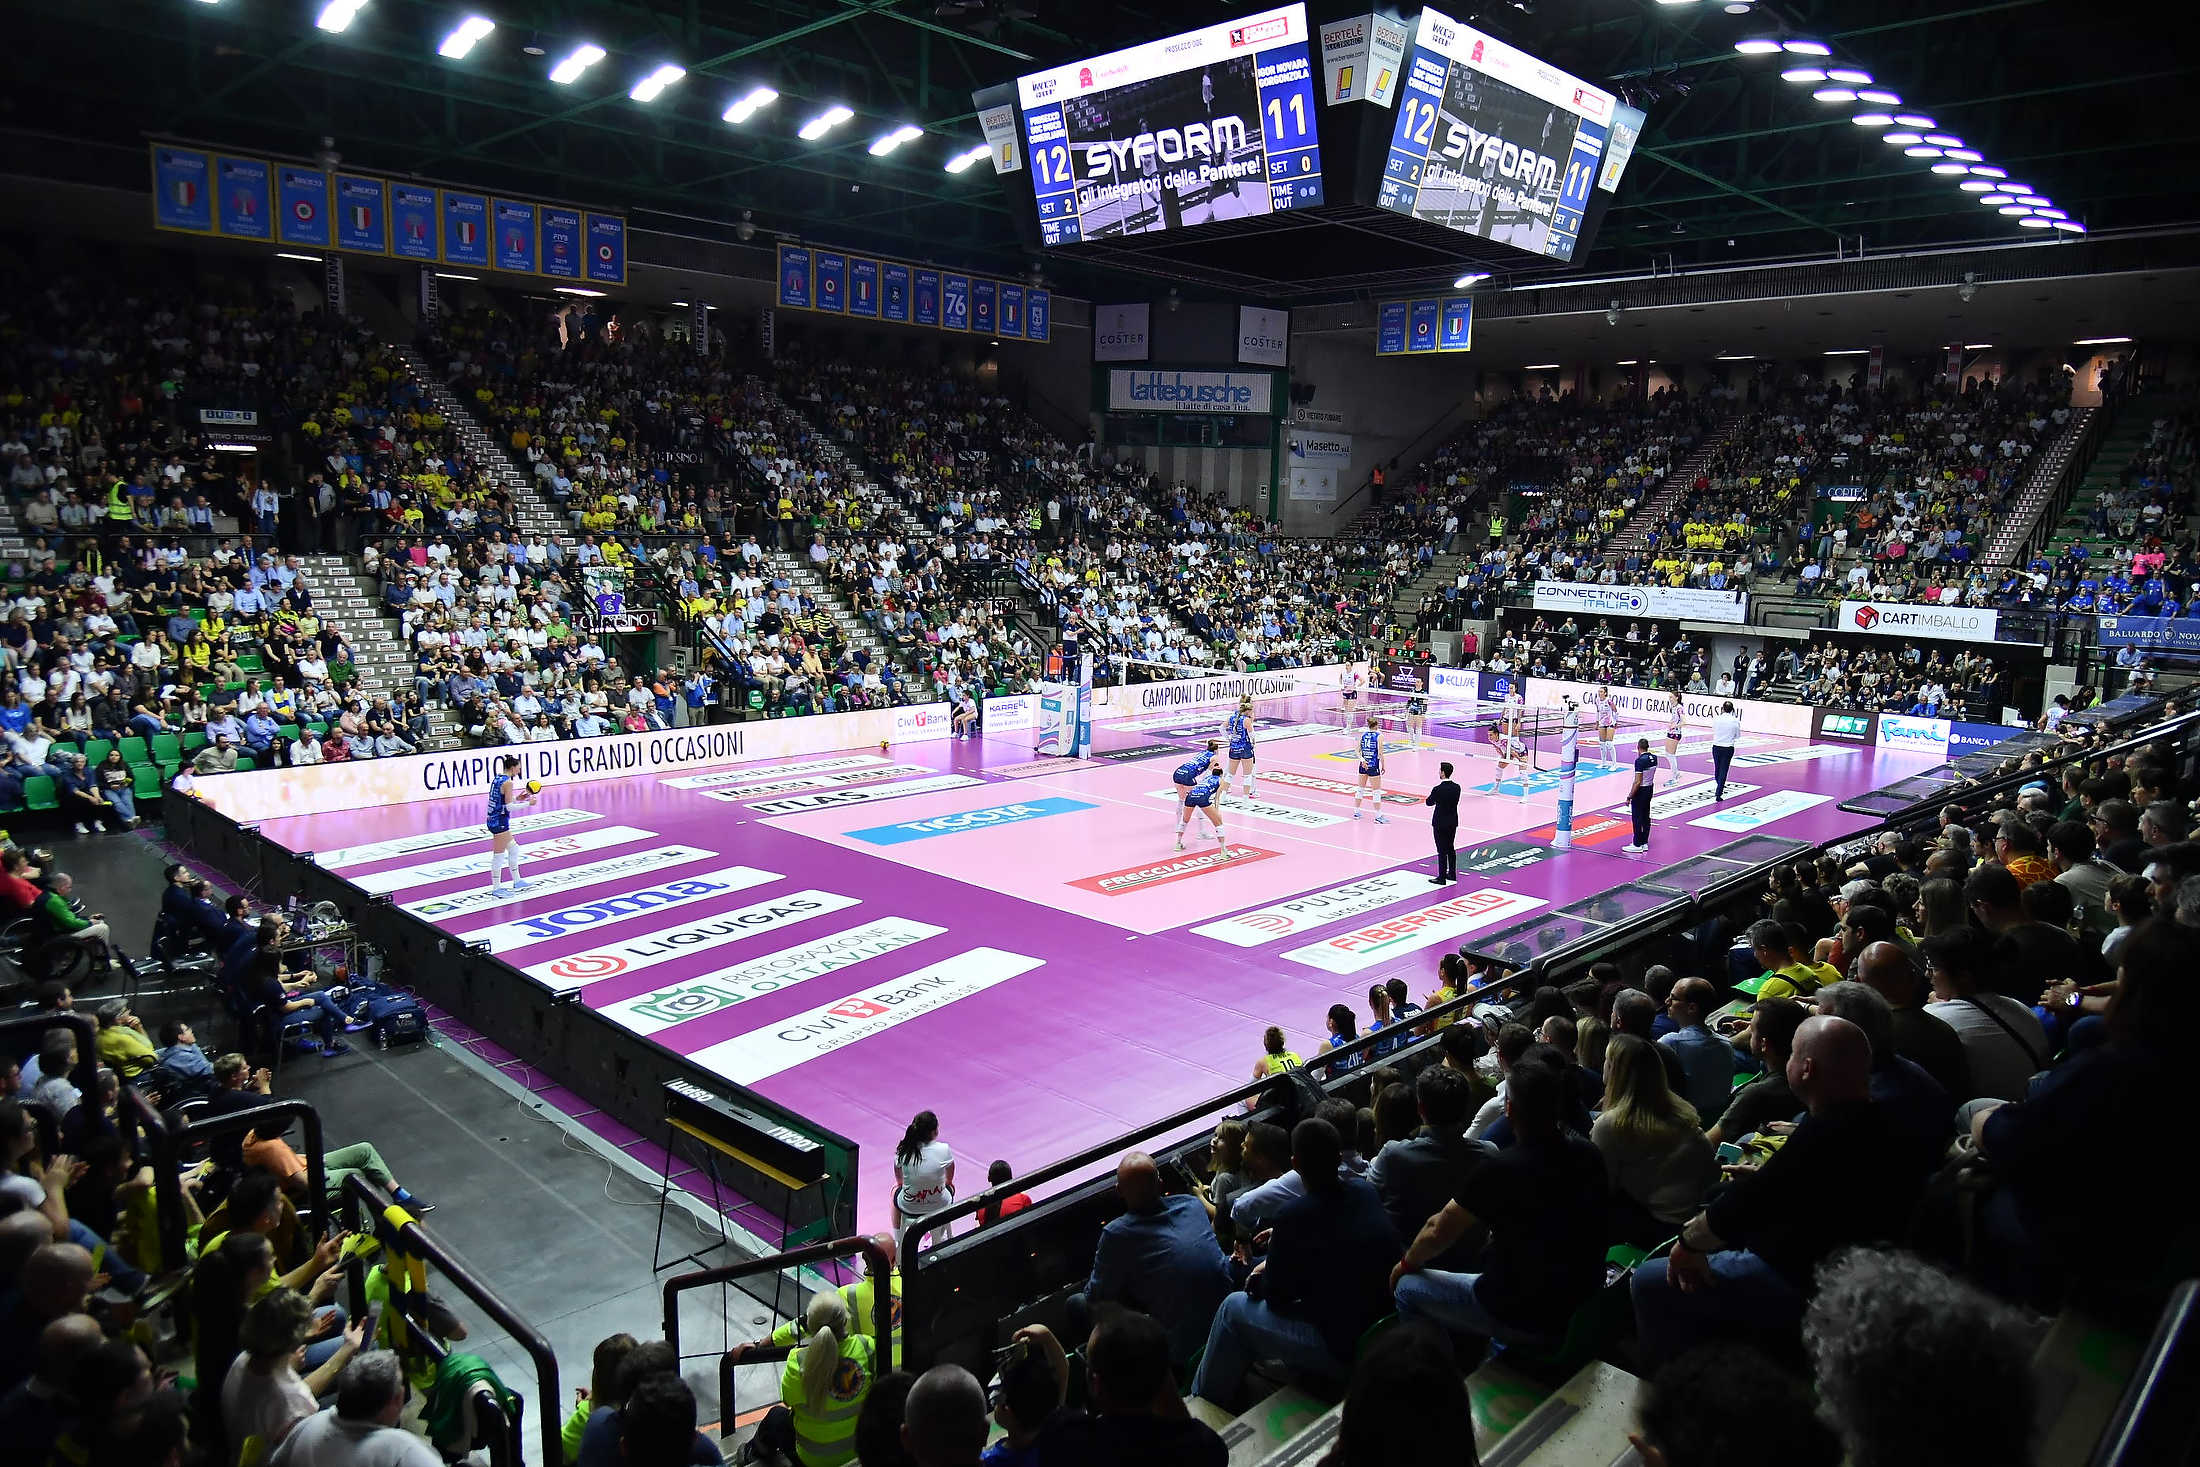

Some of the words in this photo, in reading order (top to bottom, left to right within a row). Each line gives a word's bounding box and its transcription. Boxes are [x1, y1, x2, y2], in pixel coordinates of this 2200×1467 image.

[1267, 93, 1307, 140] 11
[1404, 97, 1435, 146] 12
[1086, 115, 1247, 178] SYFORM
[1441, 123, 1557, 190] SYFORM
[1035, 146, 1070, 185] 12
[1164, 168, 1198, 189] delle
[1200, 155, 1261, 184] Pantere!
[1270, 160, 1288, 174] SET
[1301, 155, 1311, 172] 0
[1389, 158, 1404, 172] SET
[1410, 165, 1419, 180] 2
[1271, 183, 1294, 198] TIME
[1382, 180, 1400, 194] TIME
[1566, 162, 1591, 201] 11
[1273, 196, 1293, 210] OUT
[1381, 196, 1396, 208] OUT
[1492, 183, 1515, 206] delle
[1041, 202, 1056, 214] SET
[1064, 198, 1072, 213] 2
[1042, 222, 1060, 233] TIME
[1554, 213, 1566, 226] SET
[1045, 233, 1060, 245] OUT
[945, 293, 967, 316] 76
[1100, 334, 1144, 345] COSTER
[1243, 336, 1283, 350] COSTER
[1306, 440, 1340, 452] Masetto
[1882, 612, 1979, 629] CARTIMBALLO
[2109, 630, 2160, 638] BALUARDO
[1446, 675, 1476, 688] ECLISSE
[1143, 684, 1192, 708] CAMPIONI
[1195, 682, 1206, 702] DI
[1209, 680, 1245, 701] GRANDI
[1632, 700, 1643, 711] DI
[1646, 699, 1673, 714] GRAN
[927, 712, 949, 724] Bank
[1960, 736, 1990, 746] BANCA
[540, 749, 559, 777] DI
[569, 741, 642, 774] GRANDI
[651, 730, 744, 764] OCCASIONI
[752, 790, 870, 812] ITLAS
[464, 810, 587, 838] MSSETTI
[1284, 878, 1398, 912] PULSEE
[625, 897, 823, 956] LIQUIGAS
[721, 925, 896, 986] RISTORAZIONE
[751, 932, 920, 991] OTTAVIAN
[777, 1011, 847, 1043] Civi
[873, 974, 956, 1006] Bank
[816, 1020, 887, 1050] GRUPPO
[889, 983, 981, 1023] SPARKASSE
